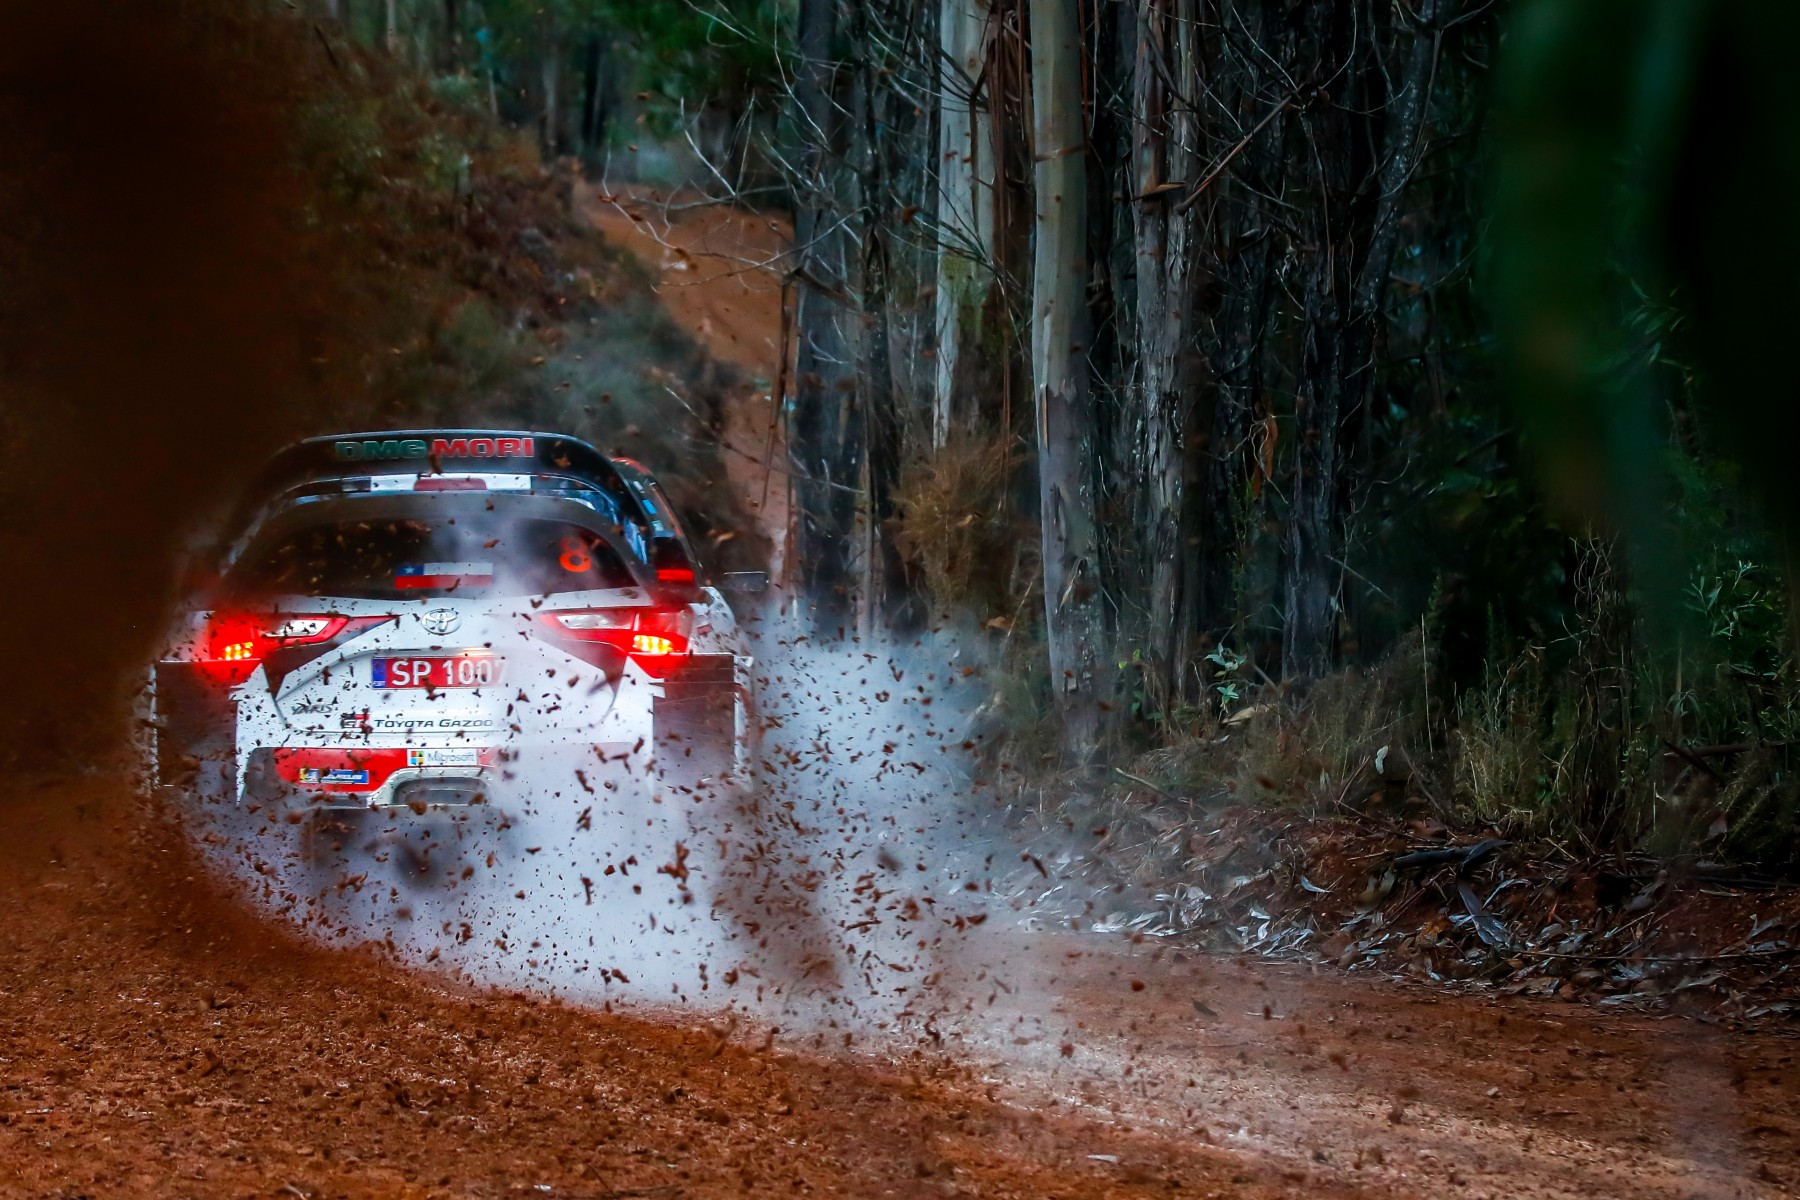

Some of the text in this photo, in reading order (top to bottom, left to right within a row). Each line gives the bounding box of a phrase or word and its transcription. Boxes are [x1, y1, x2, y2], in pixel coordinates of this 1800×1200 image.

[335, 438, 534, 460] DMG MORI
[559, 536, 592, 573] 8
[392, 660, 509, 687] SP 1007
[374, 719, 434, 728] TOYOTA
[439, 718, 494, 728] GAZOO
[427, 750, 476, 763] Microsoft
